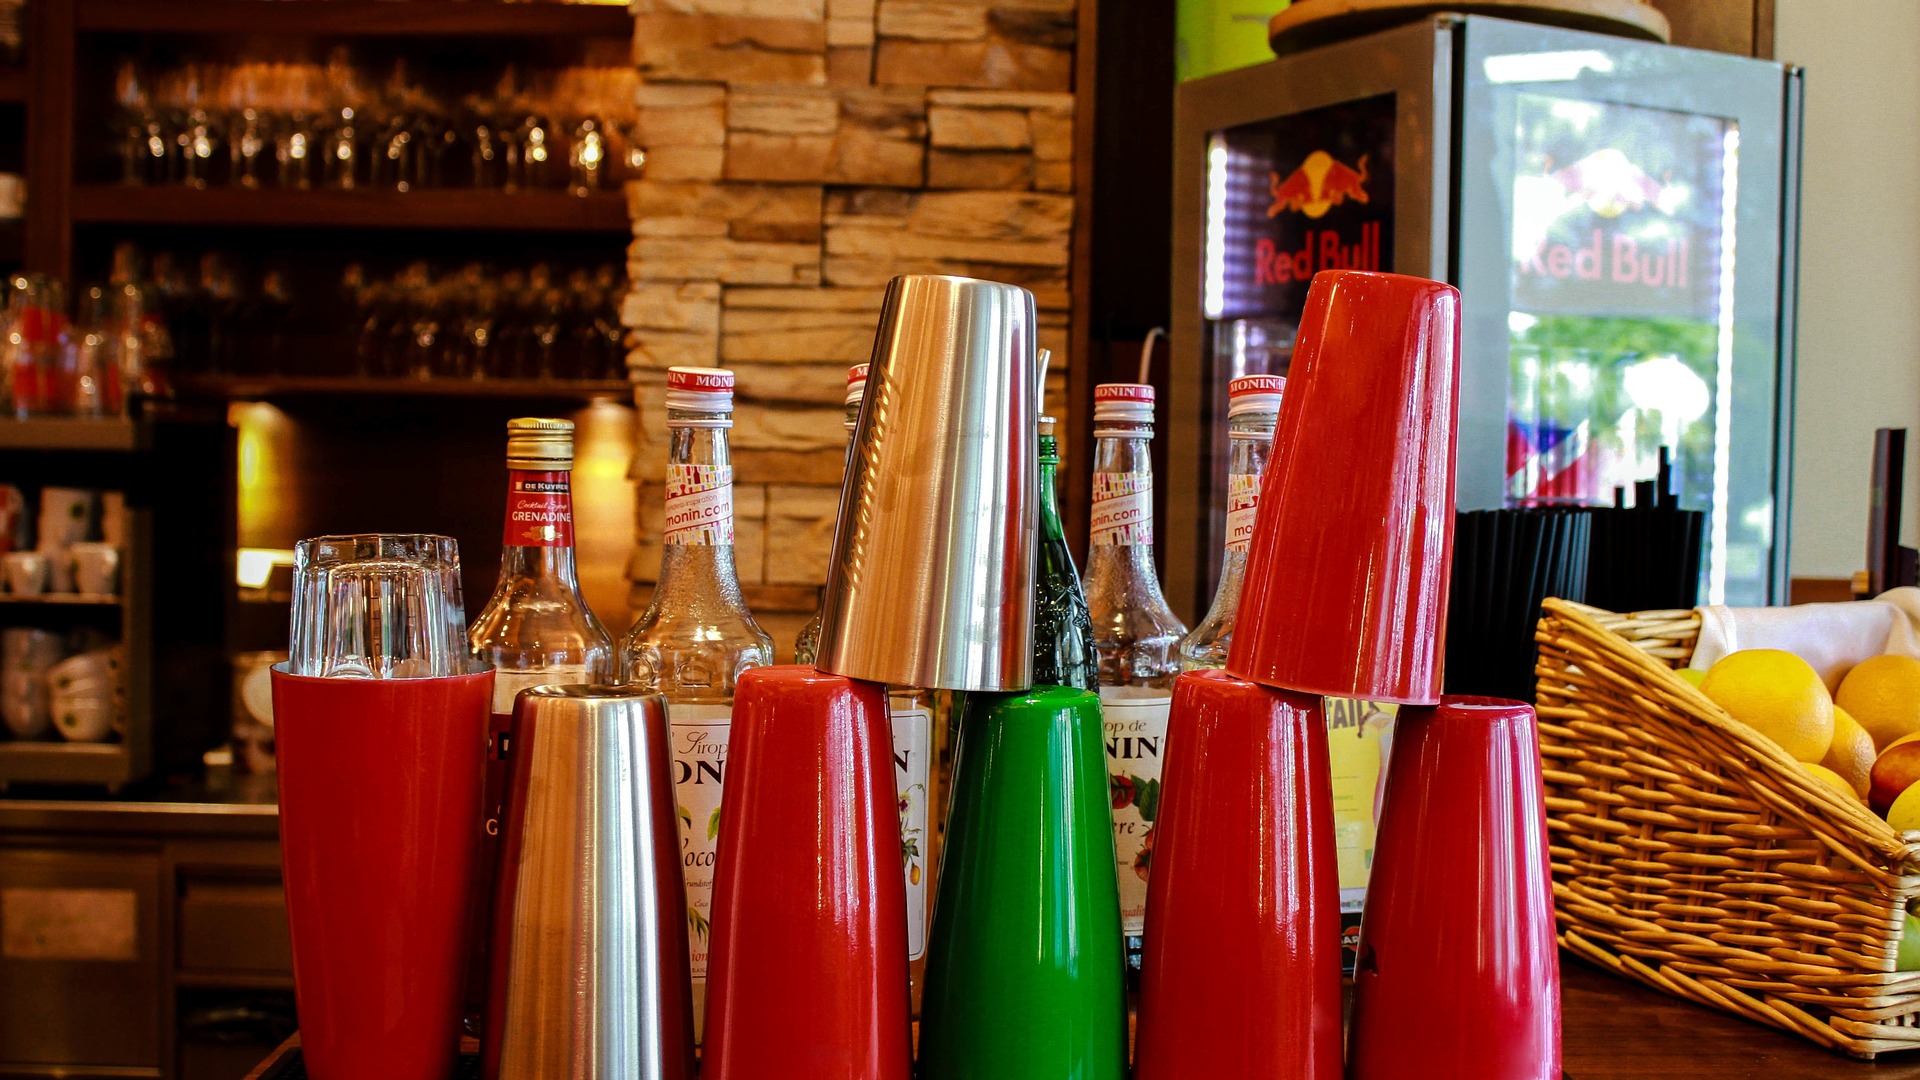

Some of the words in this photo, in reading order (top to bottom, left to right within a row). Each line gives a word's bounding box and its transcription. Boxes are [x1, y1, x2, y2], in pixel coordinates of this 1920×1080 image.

[1254, 229, 1314, 285] Red
[1319, 221, 1380, 271] Bull
[1612, 232, 1690, 288] Bull
[512, 511, 571, 523] GRENADINE
[517, 499, 548, 510] Cocktail
[665, 502, 730, 528] monin.com
[1128, 719, 1147, 733] de
[678, 731, 729, 760] Sirop
